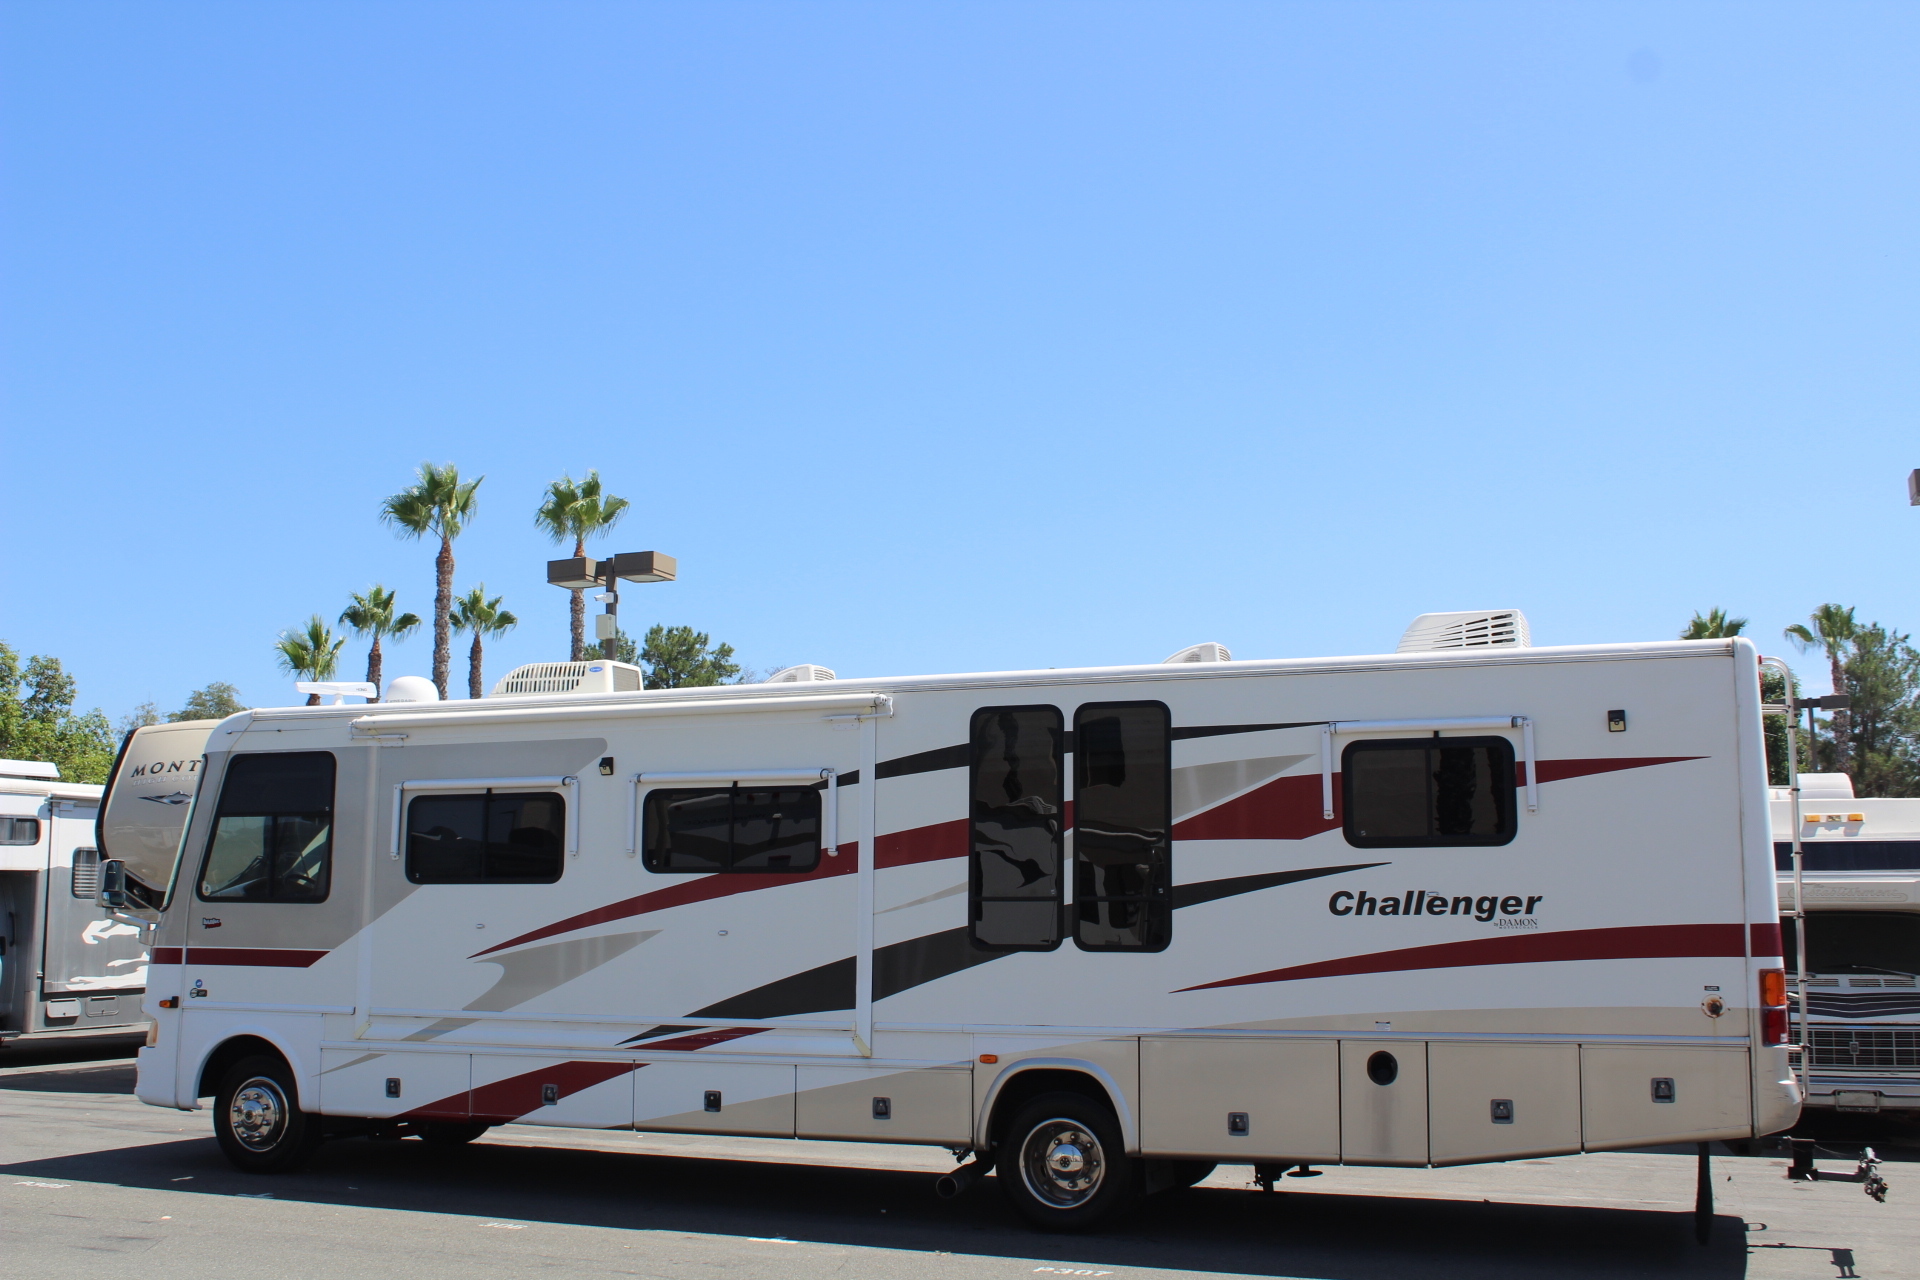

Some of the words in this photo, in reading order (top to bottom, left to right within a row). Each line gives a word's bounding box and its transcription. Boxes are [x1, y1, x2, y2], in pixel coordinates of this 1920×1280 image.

[130, 760, 202, 777] MONT
[132, 775, 168, 786] HIGH
[1328, 890, 1543, 922] Challenger
